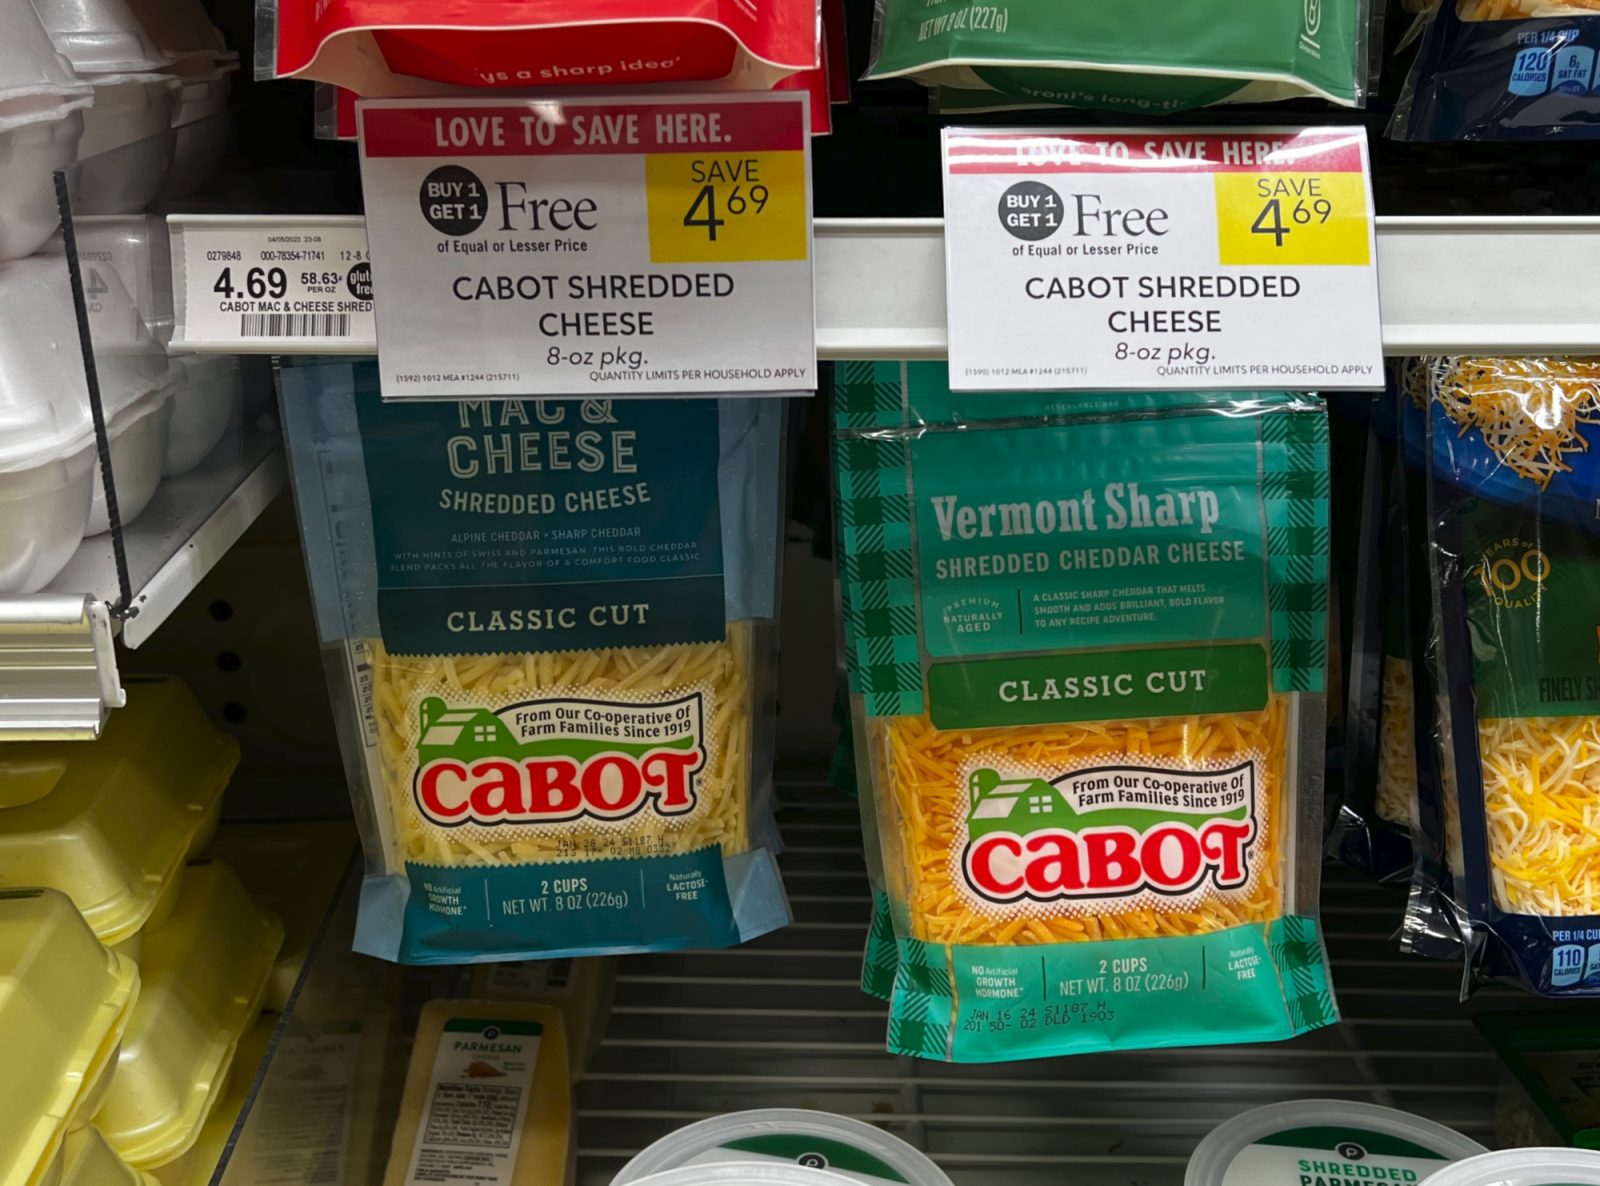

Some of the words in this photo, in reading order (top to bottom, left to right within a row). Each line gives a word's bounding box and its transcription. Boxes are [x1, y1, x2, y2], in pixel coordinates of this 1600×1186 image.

[970, 6, 1008, 32] (227g)
[1518, 32, 1537, 44] PER
[1518, 52, 1548, 71] 120
[516, 70, 532, 80] a
[540, 64, 612, 78] sharp
[435, 116, 504, 147] LOVE
[520, 116, 556, 146] TO
[572, 114, 638, 145] SAVE
[656, 112, 732, 143] HERE.
[1096, 141, 1130, 164] TO
[1144, 142, 1206, 164] SAVE
[691, 160, 759, 183] SAVE
[428, 182, 463, 197] BUY
[468, 182, 480, 197] 1
[1257, 178, 1321, 198] SAVE
[494, 182, 598, 231] Free
[1007, 195, 1040, 208] BUY
[1045, 195, 1056, 208] 1
[430, 204, 464, 220] GET
[470, 204, 482, 220] 1
[1007, 214, 1042, 227] GET
[1046, 214, 1058, 226] 1
[1071, 194, 1169, 236] Free
[438, 241, 450, 252] of
[454, 240, 488, 254] Equal
[493, 242, 504, 252] or
[510, 240, 550, 252] Lesser
[555, 238, 588, 251] Price
[1012, 245, 1024, 256] of
[1028, 244, 1062, 258] Equal
[1066, 246, 1078, 256] or
[1083, 244, 1122, 255] Lesser
[1127, 243, 1158, 254] Price
[207, 251, 241, 260] 0279848
[214, 267, 287, 298] 4.69
[452, 276, 558, 300] CABOT
[568, 273, 734, 298] SHREDDED
[1025, 277, 1128, 299] CABOT
[1138, 276, 1300, 298] SHREDDED
[220, 302, 255, 312] CABOT
[258, 302, 280, 312] MAC
[284, 302, 290, 312] &
[294, 302, 334, 312] CHEESE
[338, 302, 372, 312] SHRED
[538, 312, 654, 338] CHEESE
[1108, 310, 1222, 333] CHEESE
[546, 346, 594, 366] 8-oz
[600, 346, 648, 369] pkg.
[1115, 342, 1161, 362] 8-oz
[1168, 342, 1216, 366] pkg.
[422, 374, 441, 382] 1012
[443, 374, 460, 382] MEA
[486, 374, 520, 382] (215711)
[590, 371, 642, 382] QUANTITY
[646, 370, 680, 380] LIMITS
[682, 370, 700, 380] PER
[704, 369, 771, 379] HOUSEHOLD
[774, 368, 806, 378] APPLY
[1157, 366, 1210, 376] QUANTITY
[1214, 365, 1246, 374] LIMITS
[1250, 365, 1268, 374] PER
[1272, 365, 1338, 374] HOUSEHOLD
[1342, 365, 1372, 374] APPLY
[458, 400, 566, 428] MAC
[580, 400, 618, 424] &
[447, 431, 638, 479] CHEESE
[440, 488, 556, 515] SHREDDED
[564, 482, 650, 512] CHEESE
[931, 488, 1098, 541] Vermont
[1104, 482, 1220, 534] Sharp
[451, 532, 488, 544] ALPINE
[490, 530, 540, 542] CHEDDAR
[552, 528, 588, 540] SHARP
[591, 526, 641, 538] CHEDDAR
[650, 542, 697, 550] CHEDDAR
[936, 552, 1050, 579] SHREDDED
[1060, 545, 1160, 570] CHEDDAR
[1168, 540, 1245, 564] CHEESE
[1473, 550, 1550, 596] 100
[1042, 592, 1078, 601] CLASSIC
[1081, 590, 1109, 599] SHARP
[1112, 588, 1153, 597] CHEDDAR
[1157, 586, 1177, 594] THAT
[1180, 584, 1206, 592] MELTS
[1034, 606, 1070, 615] SMOOTH
[1094, 603, 1117, 611] ADDS
[1170, 598, 1192, 606] BOLD
[1194, 596, 1224, 606] FLAVOR
[448, 608, 576, 632] CLASSIC
[590, 604, 650, 626] CUT
[944, 612, 1003, 624] NATURALLY
[958, 622, 990, 632] AGED
[1035, 620, 1046, 628] TO
[1050, 618, 1066, 626] ANY
[1070, 616, 1100, 626] RECIPE
[999, 674, 1134, 702] CLASSIC
[1146, 670, 1206, 693] CUT
[1540, 677, 1581, 702] FINELY
[516, 708, 552, 725] From
[556, 707, 580, 720] Our
[584, 708, 672, 726] Co-operative
[672, 705, 690, 720] Of
[521, 723, 556, 738] Farm
[560, 721, 620, 736] Families
[624, 723, 660, 738] Since
[664, 720, 692, 736] 1919
[1072, 779, 1109, 794] From
[1114, 776, 1140, 789] Our
[1143, 777, 1227, 794] Co-operative
[1230, 774, 1244, 788] Of
[1078, 793, 1114, 808] Farm
[1118, 790, 1178, 806] Families
[1183, 791, 1217, 808] Since
[1221, 790, 1245, 806] 1919
[540, 881, 548, 894] 2
[554, 878, 588, 892] CUPS
[676, 890, 698, 900] FREE
[502, 900, 525, 915] NET
[530, 898, 552, 912] WT.
[556, 896, 563, 911] 8
[567, 896, 582, 910] OZ
[586, 890, 628, 910] (226g)
[1552, 930, 1570, 942] PER
[1573, 930, 1584, 941] 1/4
[1100, 960, 1107, 974] 2
[1112, 957, 1148, 972] CUPS
[1558, 950, 1580, 966] 110
[972, 966, 984, 976] NO
[1238, 968, 1256, 980] FREE
[976, 977, 1016, 987] GROWTH
[1060, 980, 1083, 996] NET
[1087, 978, 1108, 994] WT.
[1114, 978, 1120, 992] 8
[1126, 976, 1140, 992] OZ
[1145, 972, 1188, 992] (226g)
[971, 1009, 988, 1021] JAN
[998, 1010, 1012, 1020] 16
[1020, 1008, 1036, 1018] 24
[1097, 1001, 1106, 1010] H
[964, 1020, 980, 1032] 201
[1020, 1019, 1036, 1029] 02
[454, 1041, 522, 1054] PARMESAN
[1298, 1159, 1416, 1182] SHREDDED
